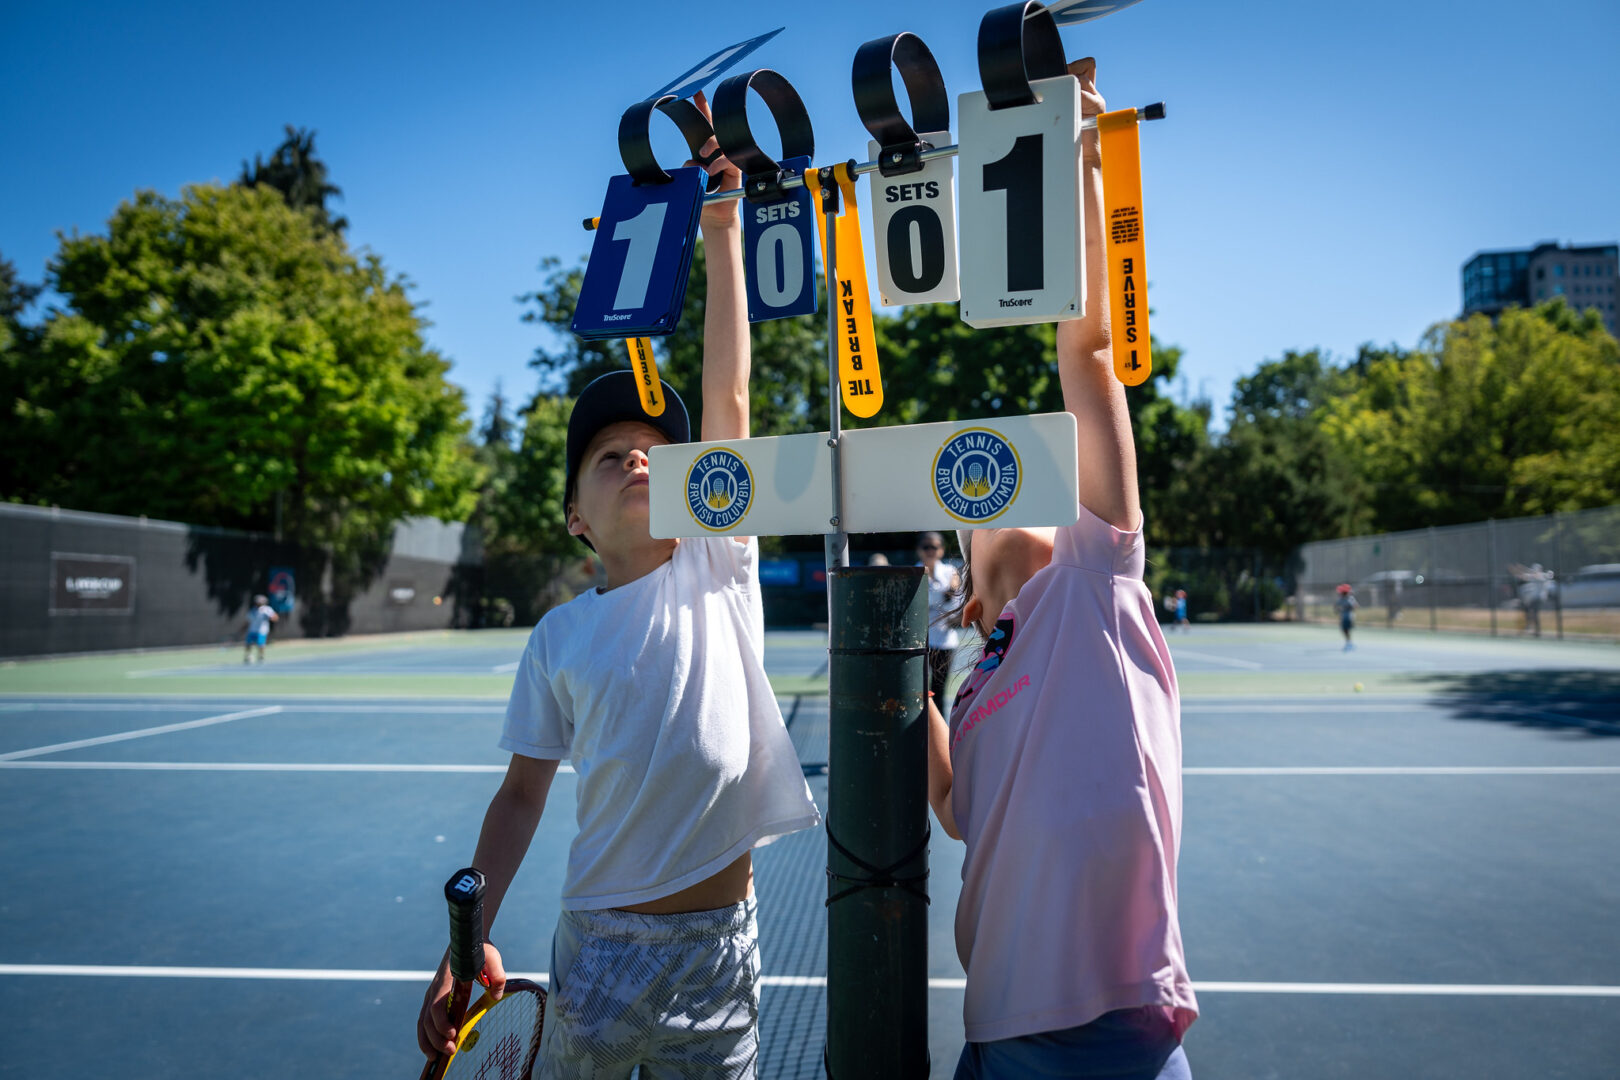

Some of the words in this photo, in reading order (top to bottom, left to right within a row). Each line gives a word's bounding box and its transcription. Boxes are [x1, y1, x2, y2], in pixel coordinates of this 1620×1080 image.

[756, 200, 801, 224] SETS
[885, 181, 940, 203] SETS
[982, 133, 1044, 293] 1
[612, 202, 668, 311] 1
[756, 223, 804, 308] 0
[886, 204, 946, 294] 0
[603, 313, 633, 322] TruScore
[998, 298, 1033, 308] TruScore
[1123, 258, 1138, 343] SERVE
[840, 280, 863, 371] BREAK
[636, 338, 651, 386] SERV
[848, 379, 874, 396] TIE
[696, 454, 740, 474] TENNIS
[947, 435, 1003, 458] TENNIS
[689, 482, 714, 524] BRITISH
[716, 479, 749, 526] COLUMBIA
[938, 468, 969, 515] BRITISH
[972, 463, 1015, 516] COLUMBIA
[962, 674, 1031, 738] ARMOUR
